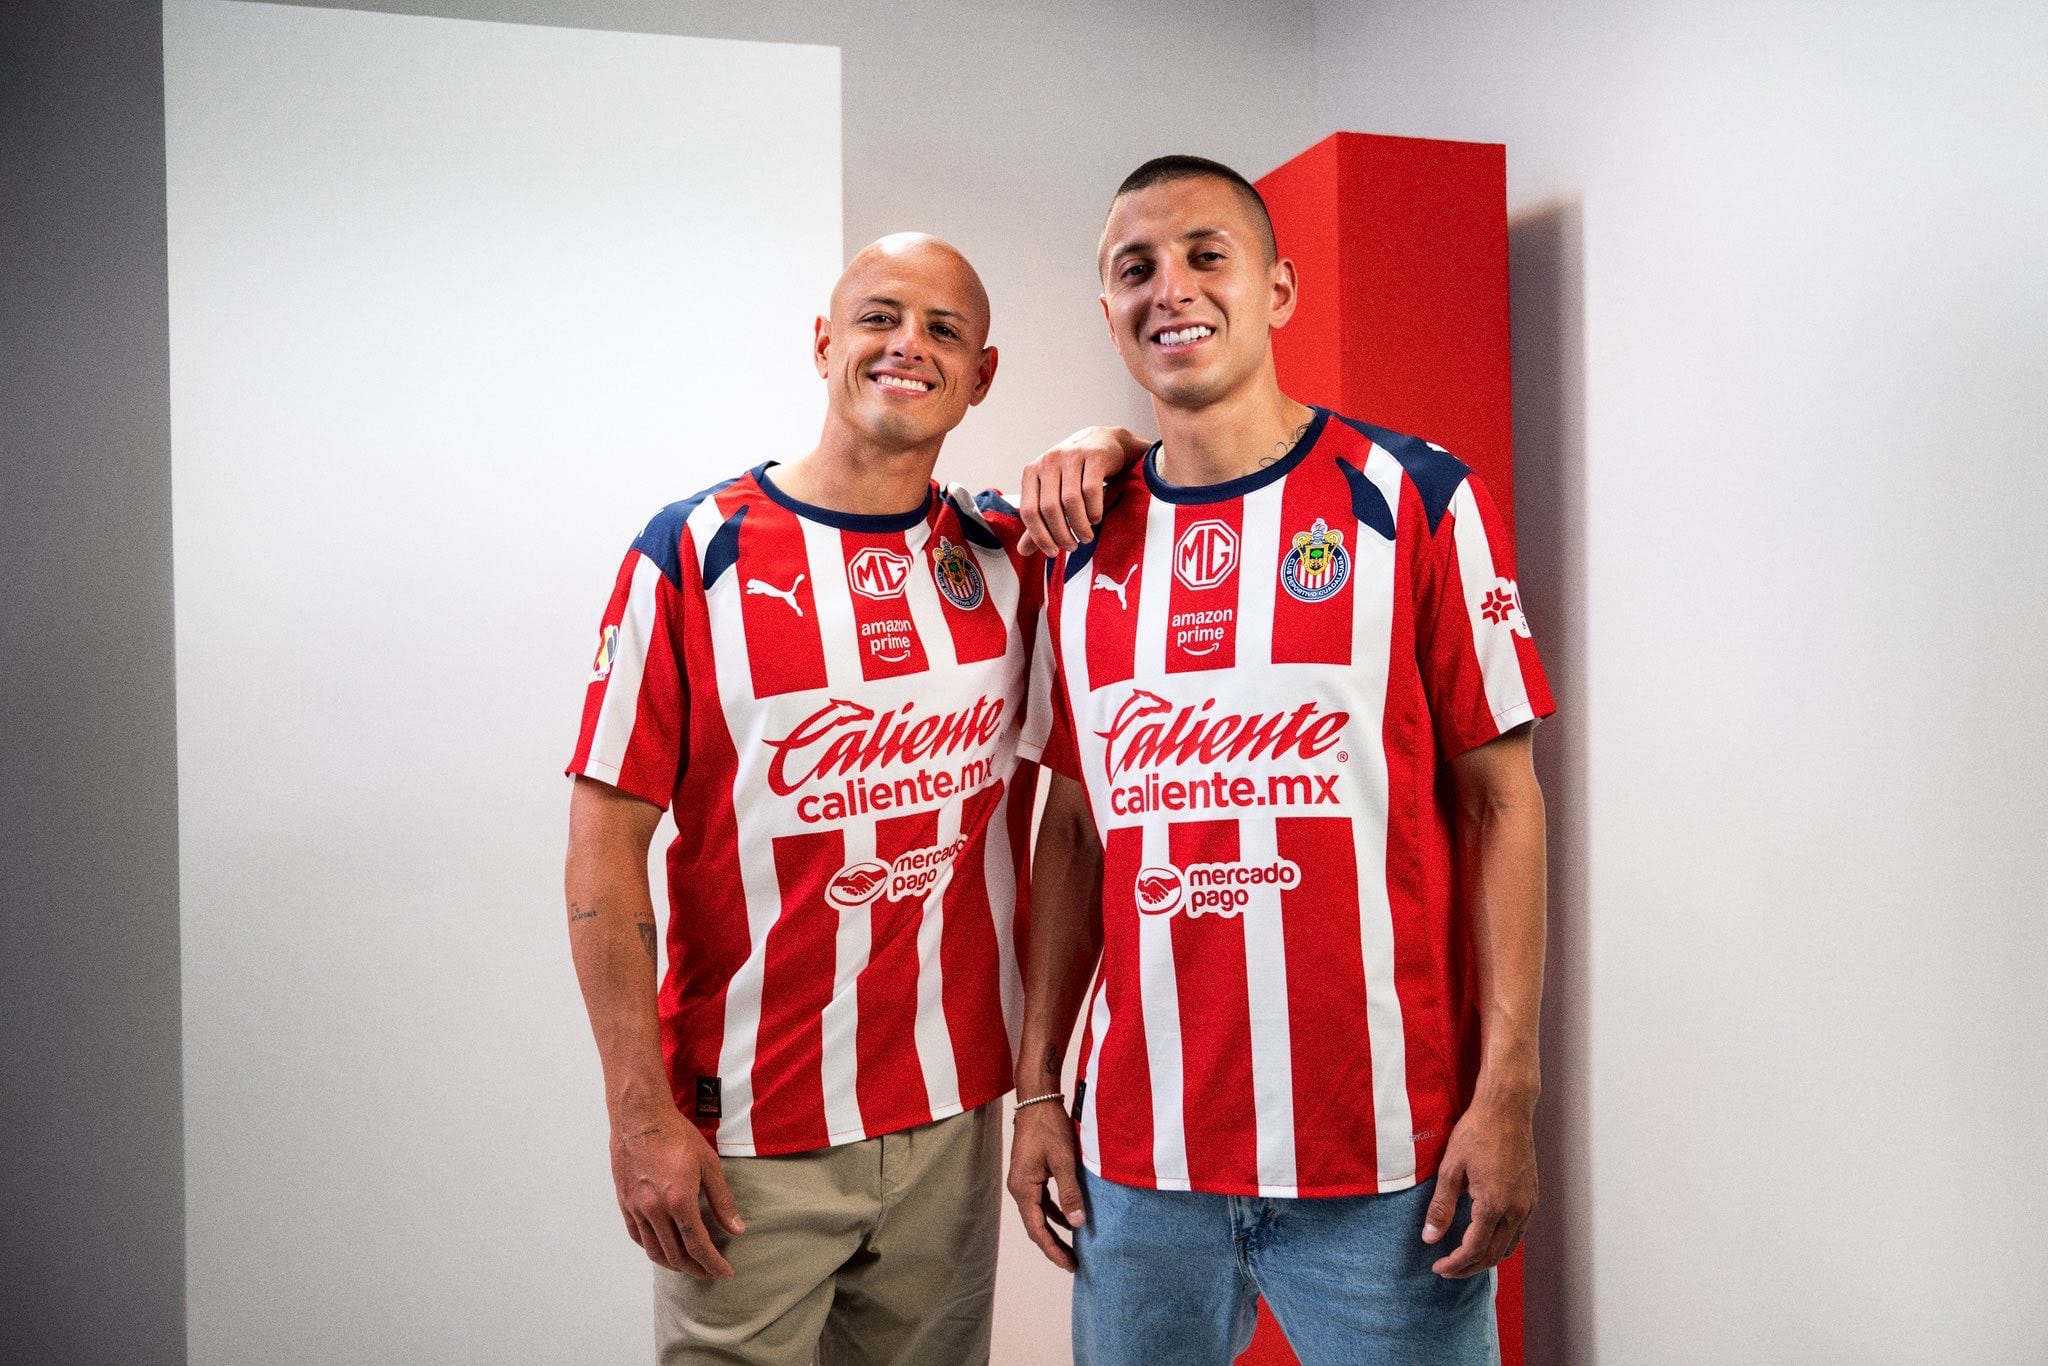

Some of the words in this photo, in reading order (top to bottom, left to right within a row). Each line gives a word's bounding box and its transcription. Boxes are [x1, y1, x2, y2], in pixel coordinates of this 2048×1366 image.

[1181, 528, 1231, 581] MG
[1286, 558, 1295, 575] CLUB
[856, 554, 908, 592] MG
[1286, 576, 1317, 598] DEPORTIVO
[1318, 555, 1345, 596] GUADALAJARA
[861, 619, 912, 636] amazon
[1171, 608, 1233, 628] amazon
[870, 633, 911, 655] prime
[1176, 627, 1224, 647] prime
[761, 694, 1004, 796] Caliente
[1093, 688, 1350, 787] Caliente
[797, 754, 995, 823] caliente.mx
[1111, 772, 1340, 816] caliente.mx
[894, 838, 966, 873] mercado
[893, 868, 937, 897] pago
[1189, 862, 1295, 887] mercado
[1191, 889, 1249, 912] pago
